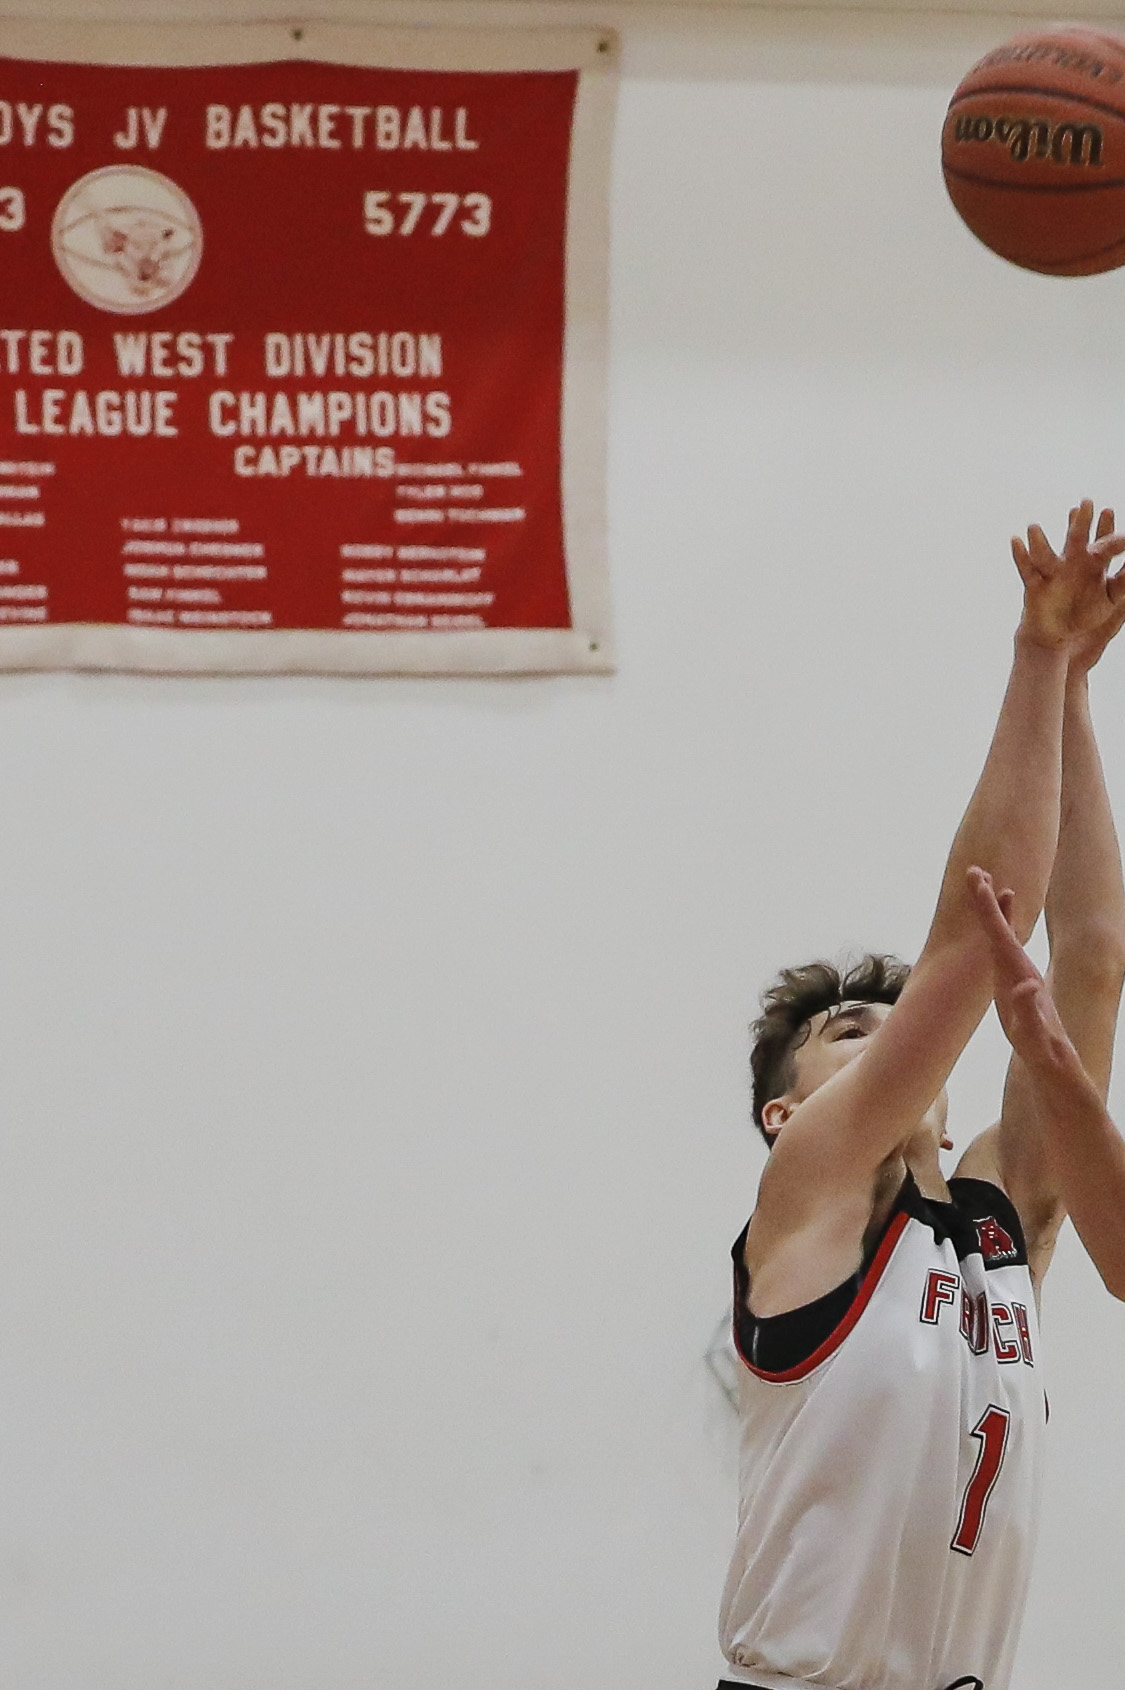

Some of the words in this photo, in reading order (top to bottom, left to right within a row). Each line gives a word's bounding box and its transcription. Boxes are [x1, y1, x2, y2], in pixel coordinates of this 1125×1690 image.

[113, 104, 168, 149] JV
[205, 102, 480, 150] BASKETBALL
[955, 114, 1103, 167] Wilson
[363, 190, 492, 237] 5773
[0, 329, 84, 376] TED
[113, 331, 235, 377] WEST
[264, 331, 442, 378] DIVISION
[14, 388, 179, 438] LEAGUE
[208, 390, 452, 439] CHAMPIONS
[233, 445, 396, 479] CAPTAINS
[951, 1404, 1010, 1556] 1
